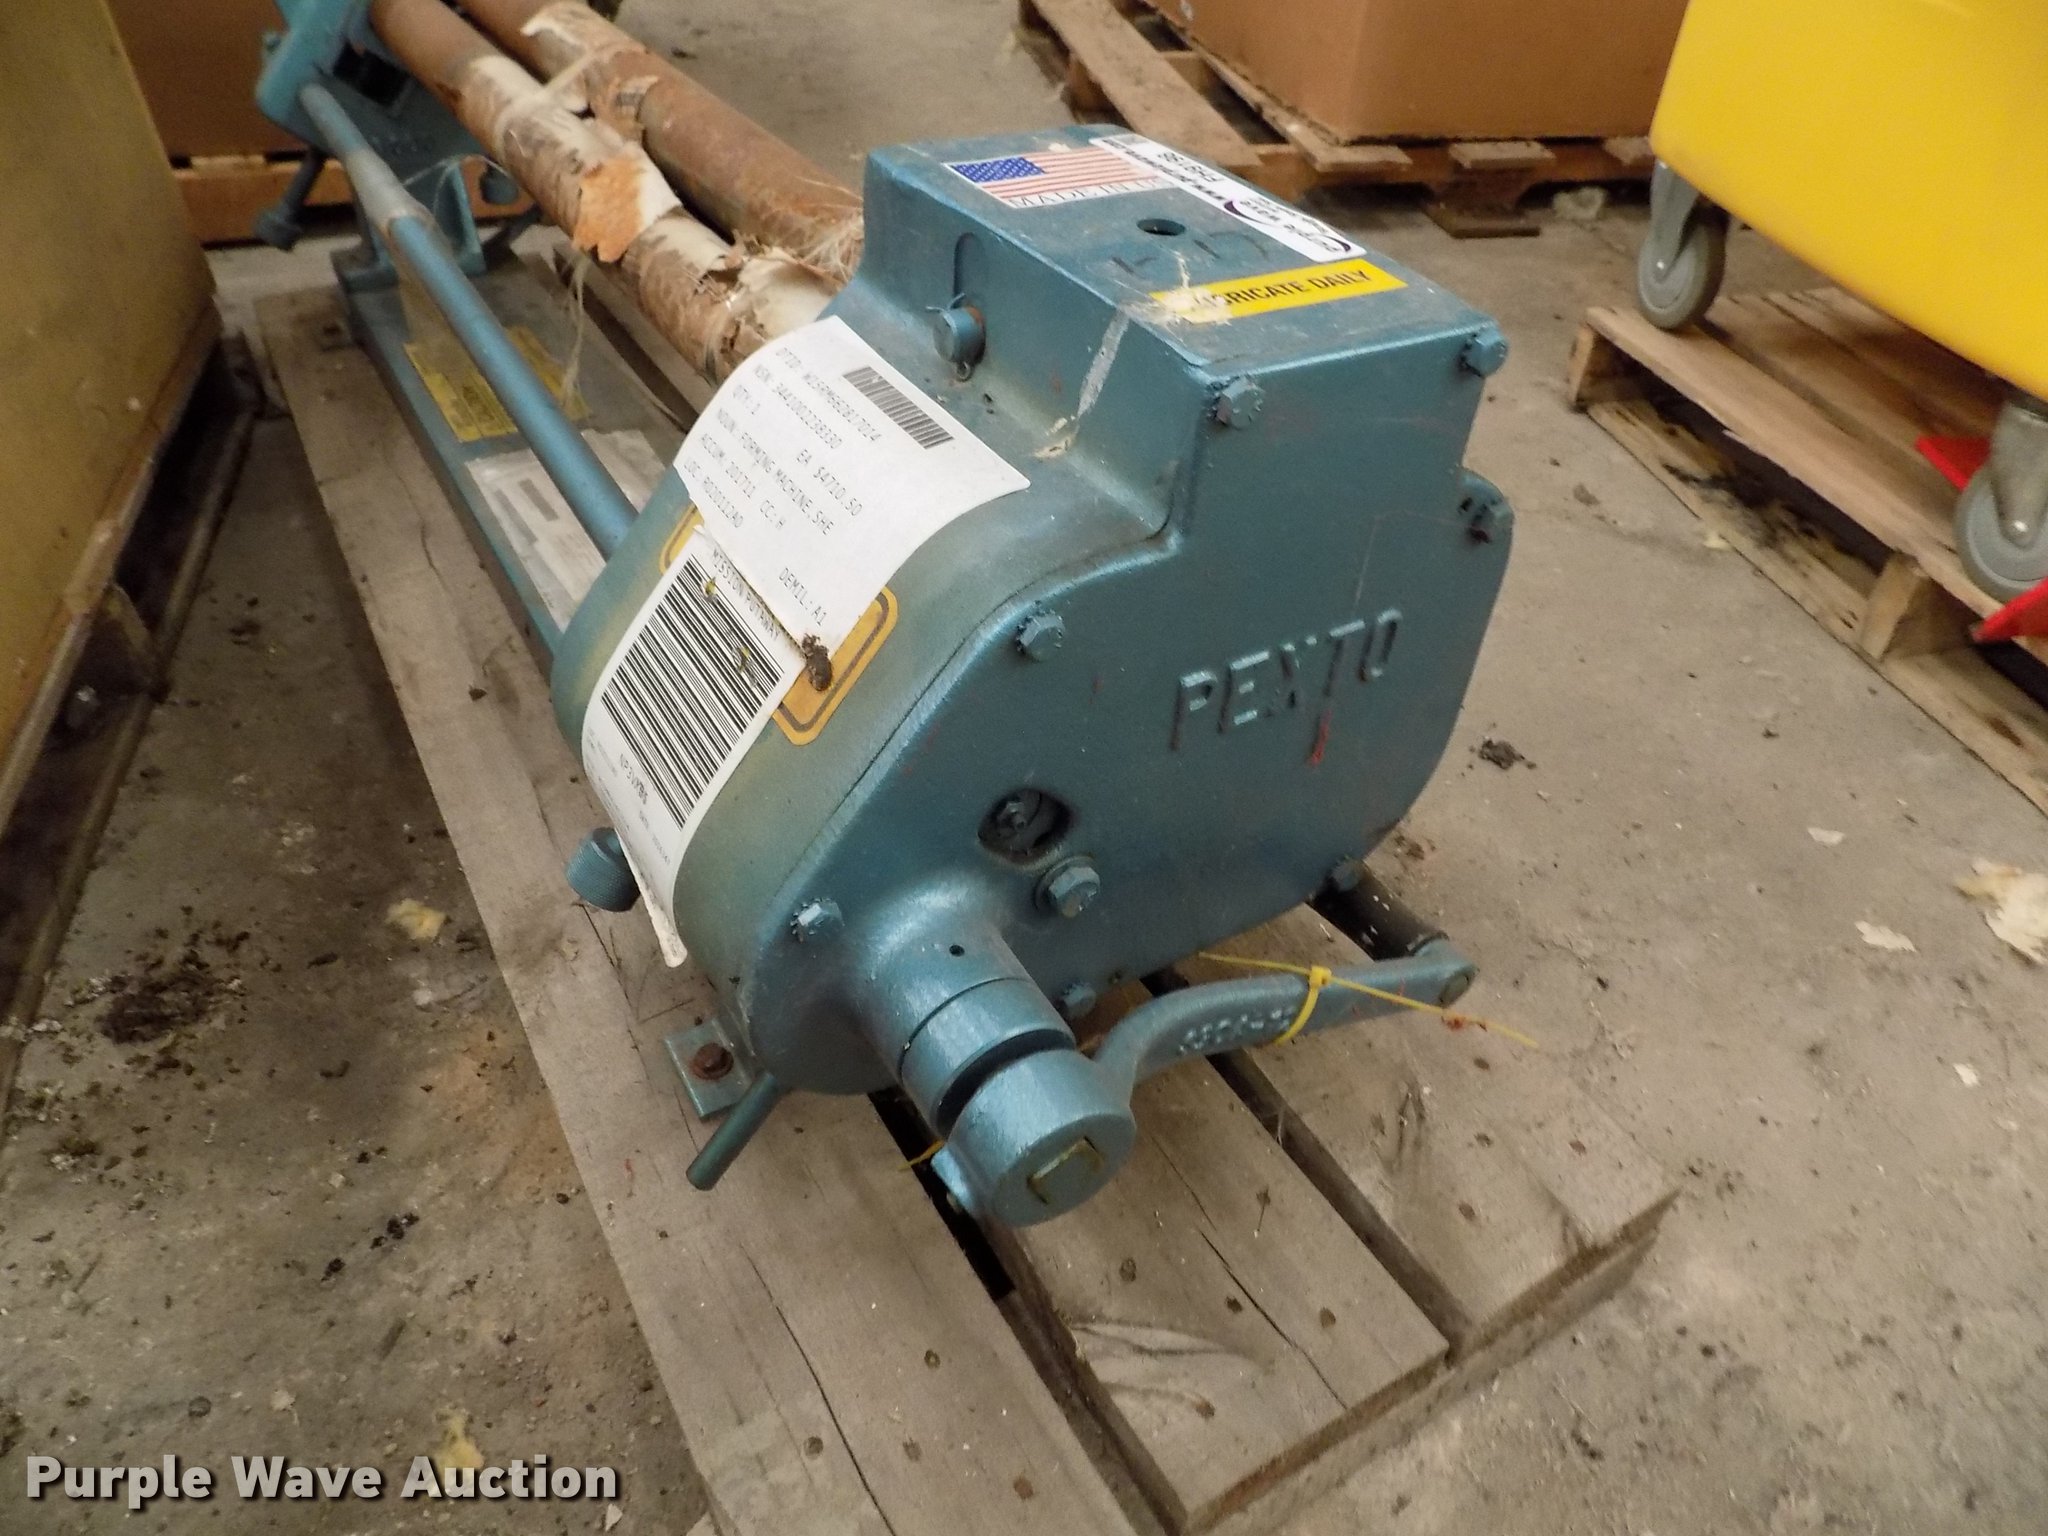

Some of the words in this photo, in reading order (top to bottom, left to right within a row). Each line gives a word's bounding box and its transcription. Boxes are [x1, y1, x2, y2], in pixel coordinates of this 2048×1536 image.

[1307, 269, 1373, 290] DAILY
[796, 448, 813, 465] EA
[711, 547, 745, 597] MISSION
[744, 591, 781, 642] PUTAWAY
[1168, 607, 1403, 753] PEXTO
